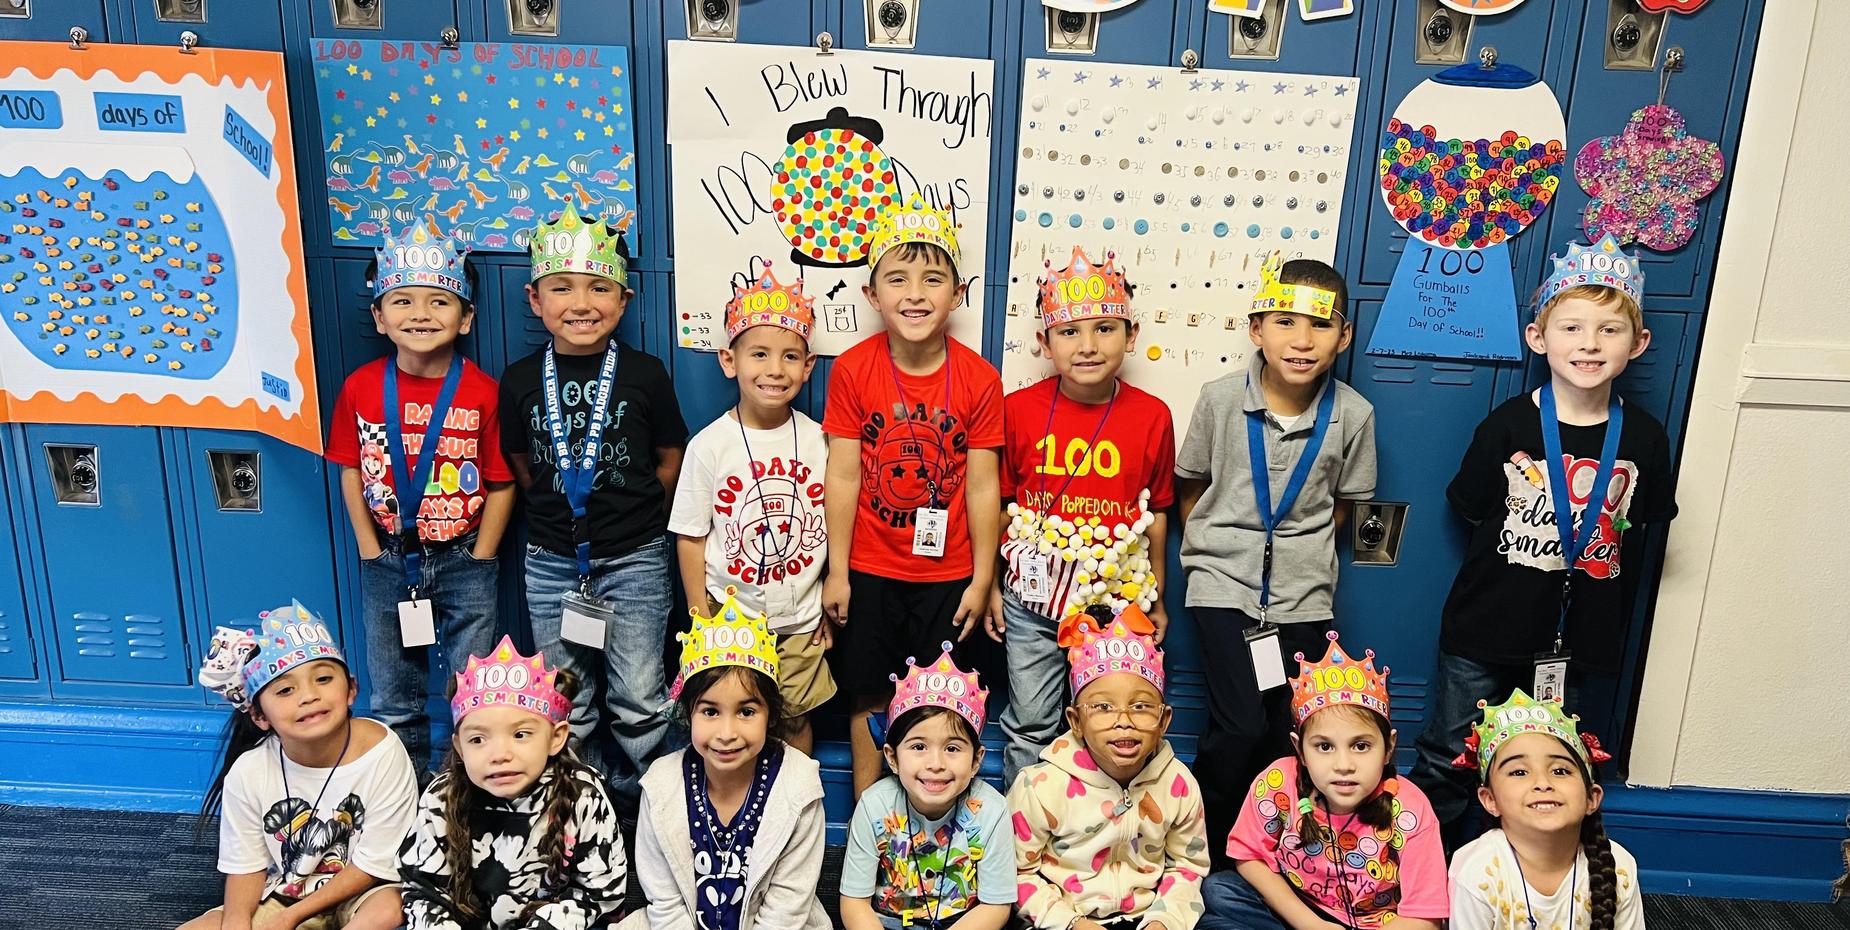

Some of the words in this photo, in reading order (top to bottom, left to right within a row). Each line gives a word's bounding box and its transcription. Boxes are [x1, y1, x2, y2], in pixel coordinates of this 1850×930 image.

[313, 40, 362, 61] 100
[380, 41, 462, 65] DAYS
[473, 44, 501, 63] OF
[508, 45, 603, 71] SCHOOL
[703, 86, 730, 127] I
[761, 61, 848, 113] Blew
[873, 65, 992, 149] Through
[0, 95, 46, 121] 100
[101, 103, 148, 128] days
[154, 101, 180, 124] of
[225, 112, 269, 172] School!
[700, 150, 775, 235] 100
[894, 213, 941, 232] 100
[395, 246, 445, 270] 100
[1416, 247, 1485, 275] 100
[1579, 252, 1631, 280] 100
[381, 273, 402, 290] DAYS
[408, 272, 463, 292] SMARTER
[1057, 275, 1105, 304] 100
[1413, 275, 1470, 294] Gumballs
[1553, 274, 1587, 292] DAYS
[743, 291, 789, 316] 100
[1418, 292, 1433, 304] For
[1441, 296, 1457, 308] The
[752, 314, 809, 336] SMARTER
[1045, 308, 1068, 325] DAYS
[1072, 303, 1126, 317] SMARTER
[1408, 316, 1428, 329] Day
[1450, 327, 1484, 339] School!!
[544, 348, 556, 378] PRIDE
[592, 379, 612, 421] BADGER
[602, 350, 618, 378] PRIDE
[545, 378, 561, 421] BADGER
[902, 443, 921, 456] 100
[1035, 433, 1121, 479] 100
[714, 475, 745, 518] 100
[748, 456, 812, 485] DAYS
[417, 496, 464, 520] AYS
[762, 500, 782, 511] 100
[727, 552, 814, 586] SCHOOL
[702, 625, 756, 651] 100
[1095, 639, 1145, 662] 100
[269, 650, 306, 675] DAYS
[684, 655, 710, 677] DAYS
[716, 652, 776, 676] SMARTER
[1077, 664, 1106, 686] DAYS
[1111, 661, 1163, 686] SMARTER
[475, 664, 530, 692] 100
[916, 672, 966, 699] 100
[1312, 666, 1366, 693] 100
[484, 692, 549, 715] SMARTER
[894, 695, 922, 716] DAYS
[927, 694, 981, 726] SMARTER
[1299, 695, 1325, 719] DAYS
[1330, 692, 1388, 716] SMARTER
[1496, 706, 1553, 730] 100
[1485, 729, 1509, 760] DAYS
